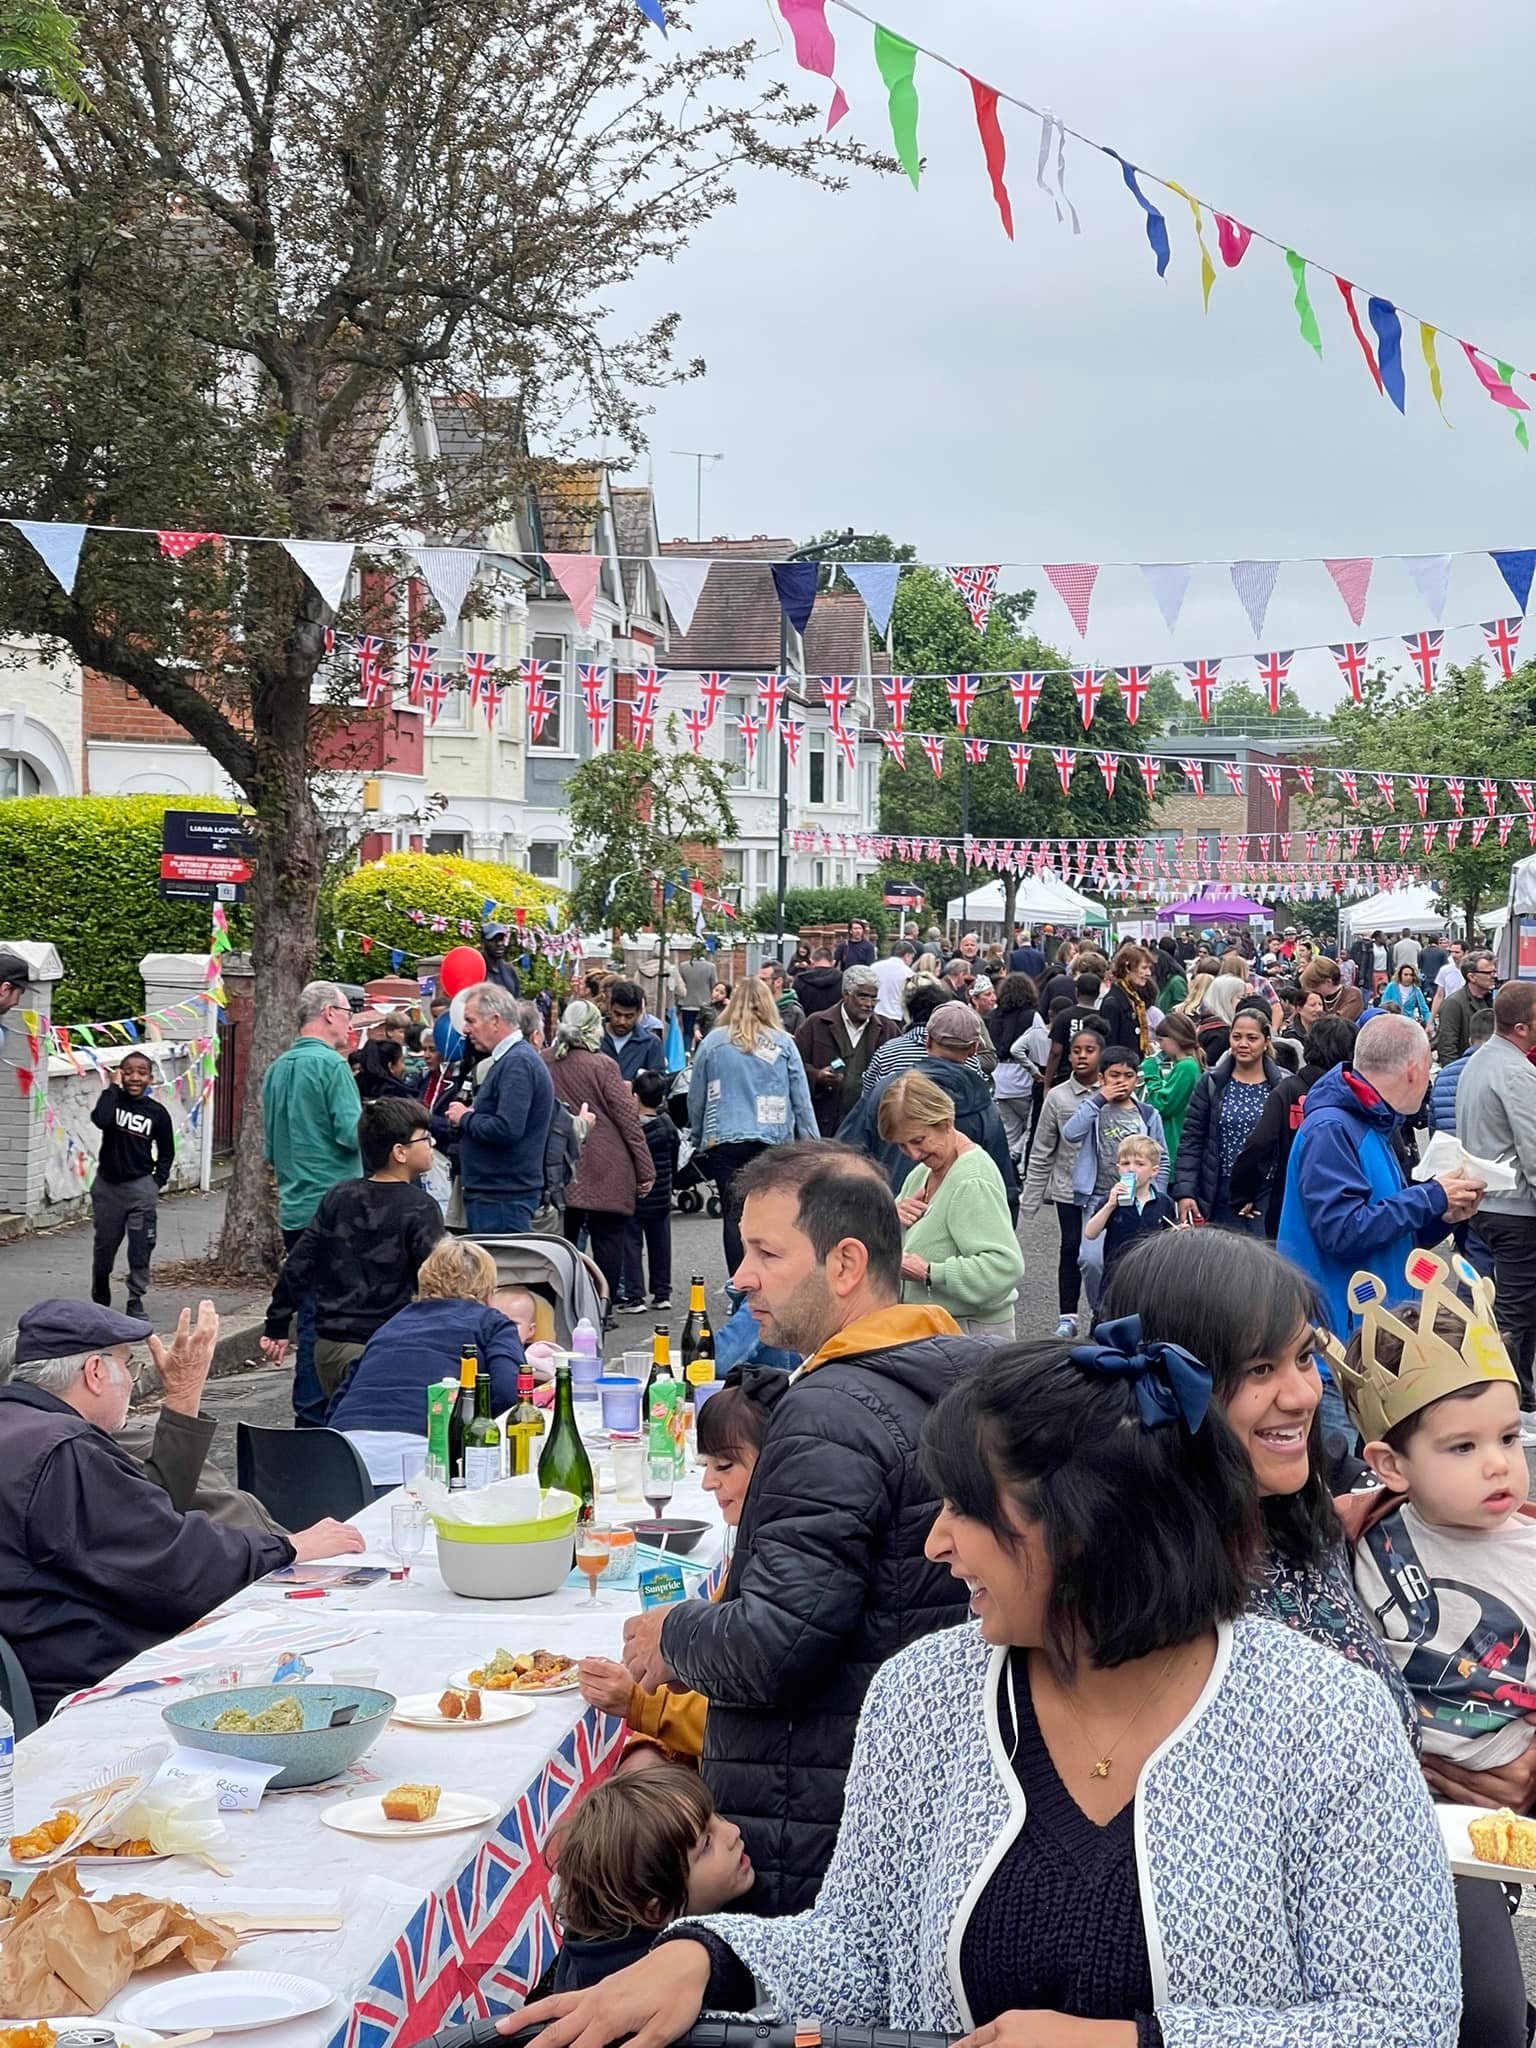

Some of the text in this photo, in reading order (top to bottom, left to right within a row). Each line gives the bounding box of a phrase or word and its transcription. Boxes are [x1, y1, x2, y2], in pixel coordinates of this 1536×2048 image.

[189, 825, 213, 833] LIANA
[116, 1107, 152, 1135] NASA
[644, 1580, 681, 1594] Sunpride
